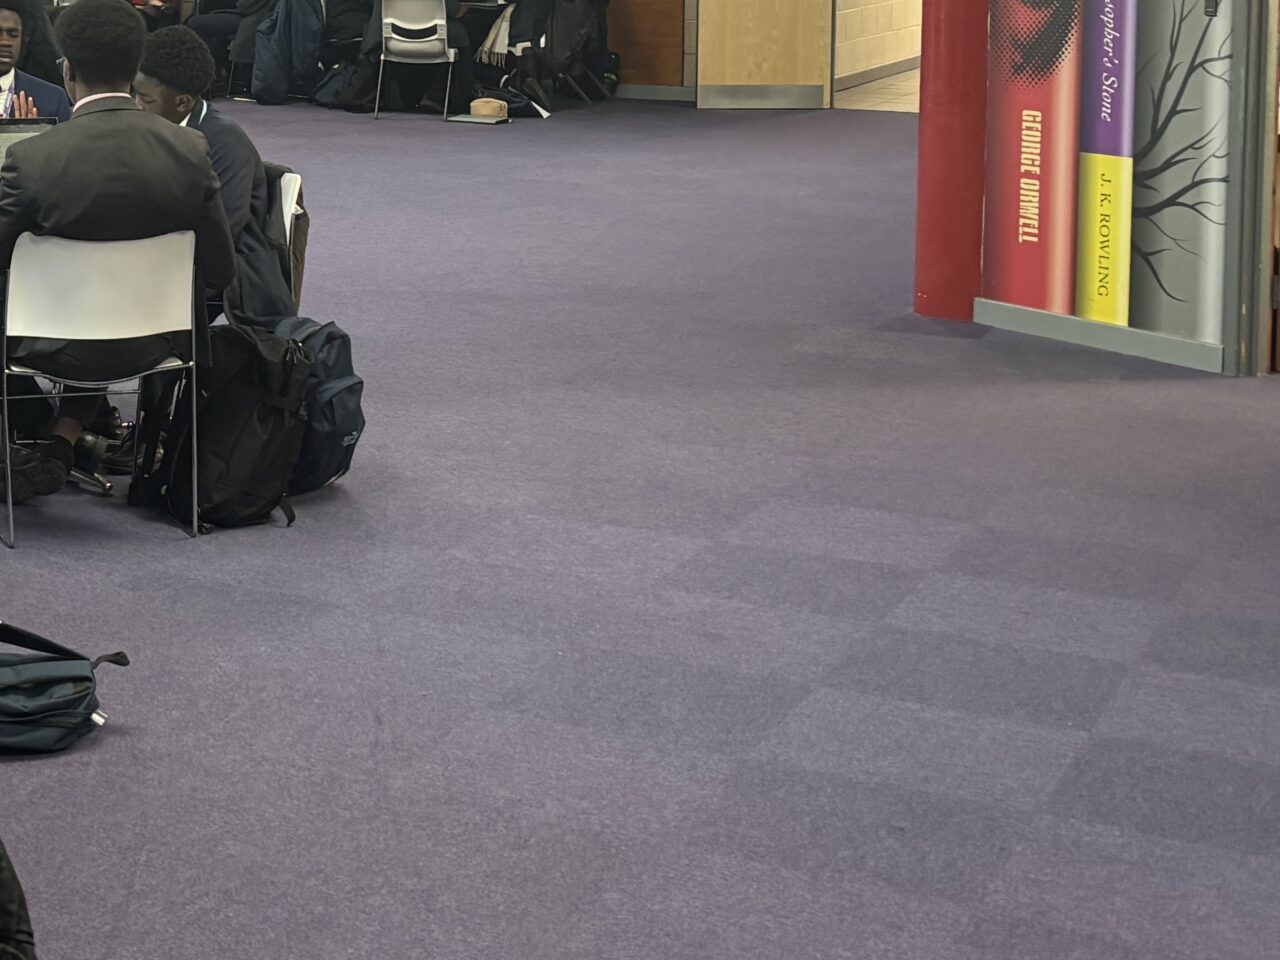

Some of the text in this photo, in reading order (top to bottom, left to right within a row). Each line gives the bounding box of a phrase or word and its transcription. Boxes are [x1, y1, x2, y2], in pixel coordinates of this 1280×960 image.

[1101, 72, 1118, 122] Stone
[1019, 109, 1043, 243] GEORGE ORWELL
[1097, 172, 1112, 297] J. K. ROWLING
